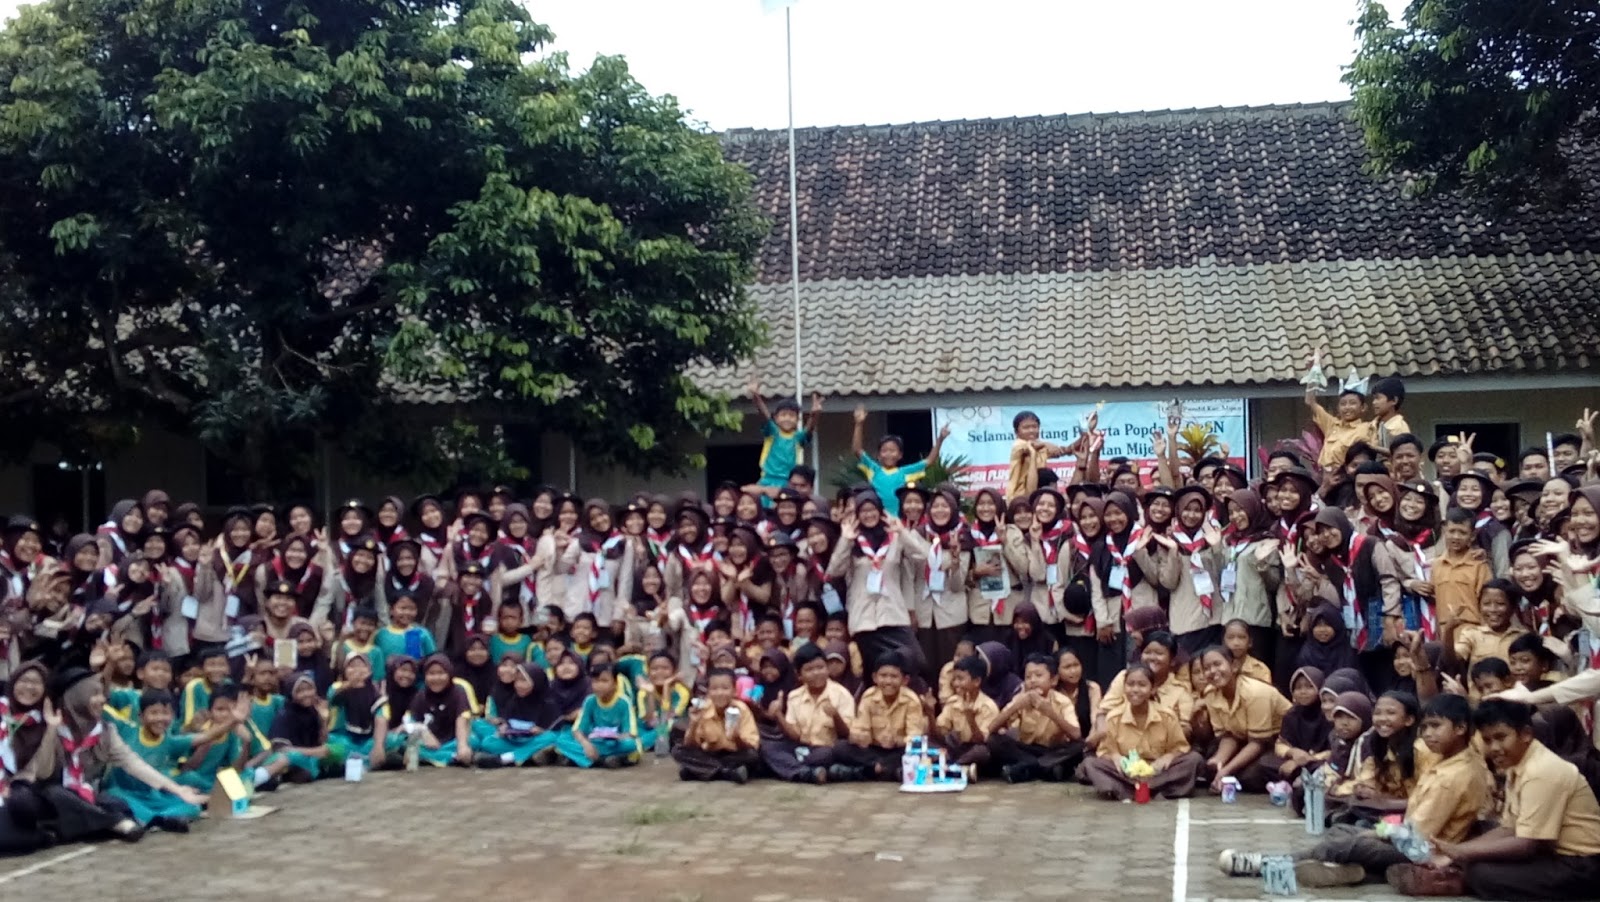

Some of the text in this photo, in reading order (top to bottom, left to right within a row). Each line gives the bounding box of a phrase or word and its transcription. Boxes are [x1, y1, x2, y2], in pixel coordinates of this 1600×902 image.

[967, 429, 1015, 443] Selama
[1041, 428, 1070, 441] tang
[1124, 422, 1165, 438] Popda
[1126, 442, 1156, 457] Mije
